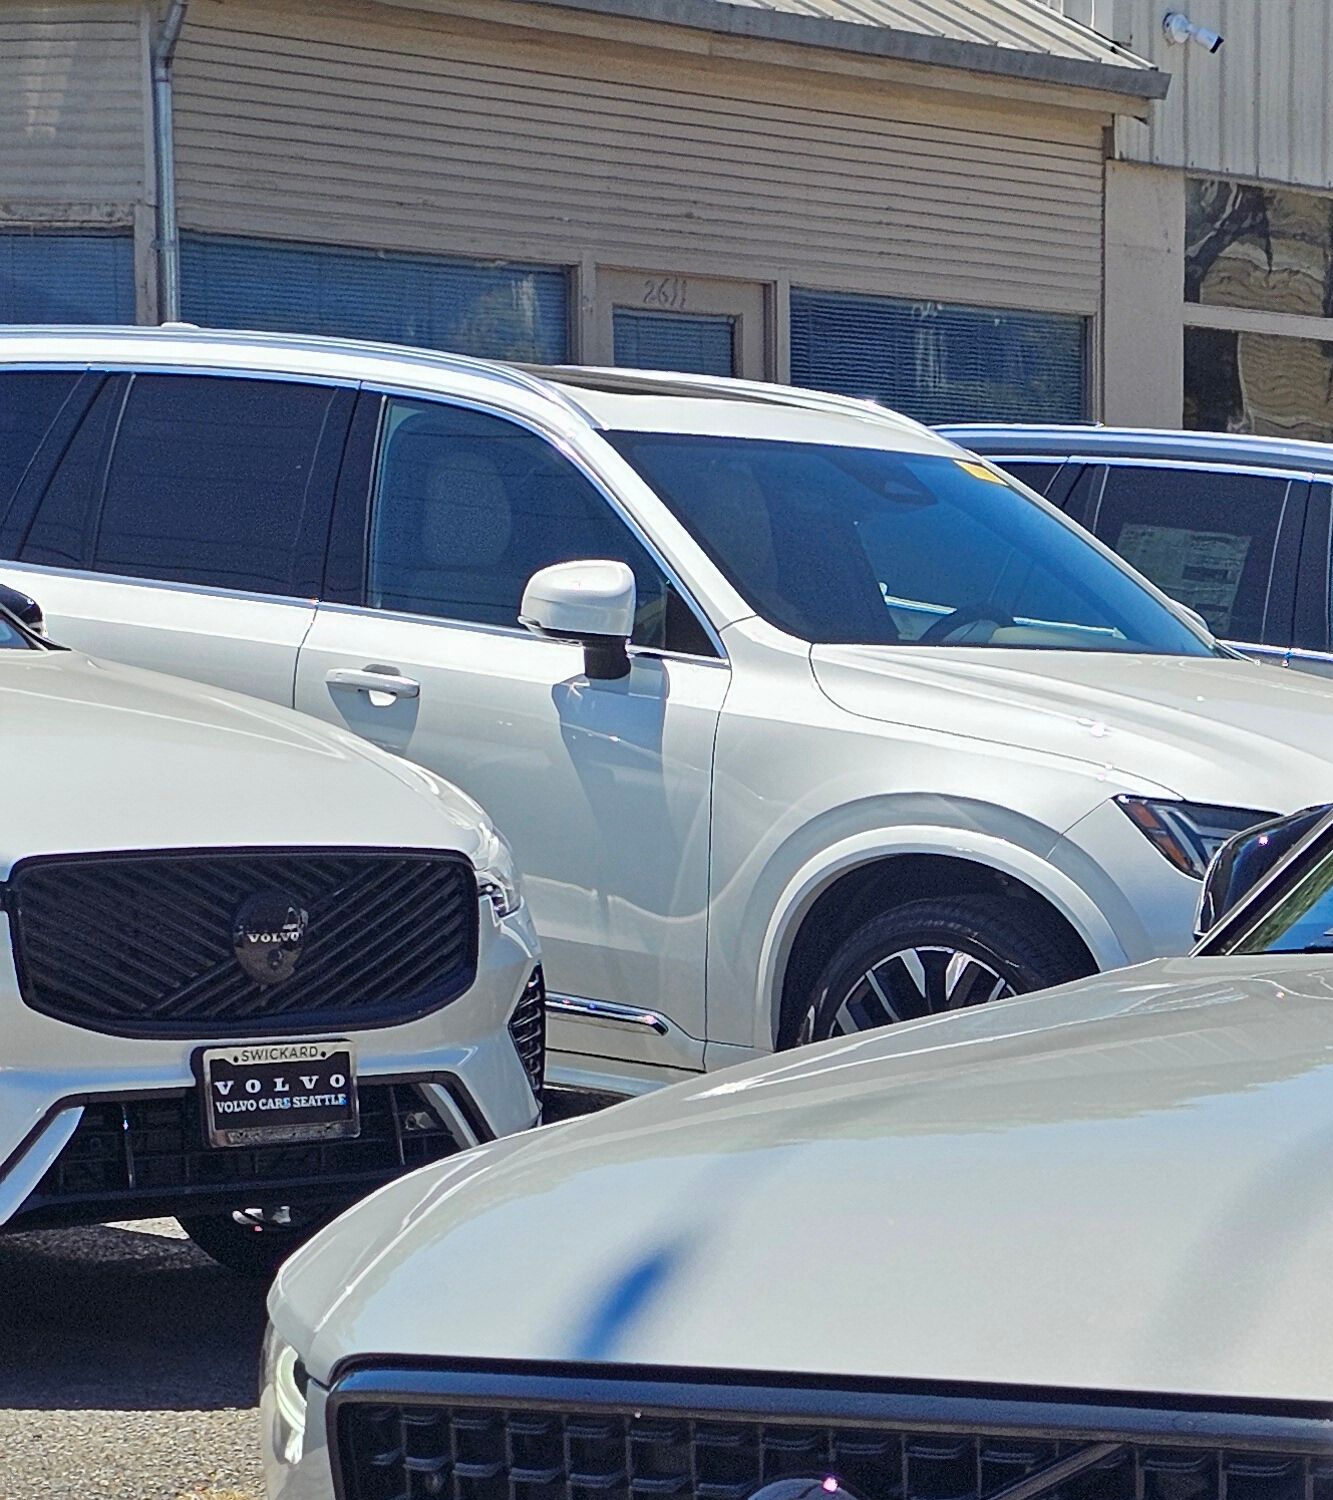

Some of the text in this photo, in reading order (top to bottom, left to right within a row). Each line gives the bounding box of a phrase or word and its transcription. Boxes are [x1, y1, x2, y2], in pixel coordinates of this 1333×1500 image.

[643, 277, 687, 308] 2611
[246, 931, 300, 943] VOLVO
[241, 1046, 318, 1063] SWICKARD
[214, 1073, 346, 1095] VOLVO
[216, 1094, 347, 1113] VOLVO CARS SEATTLE
